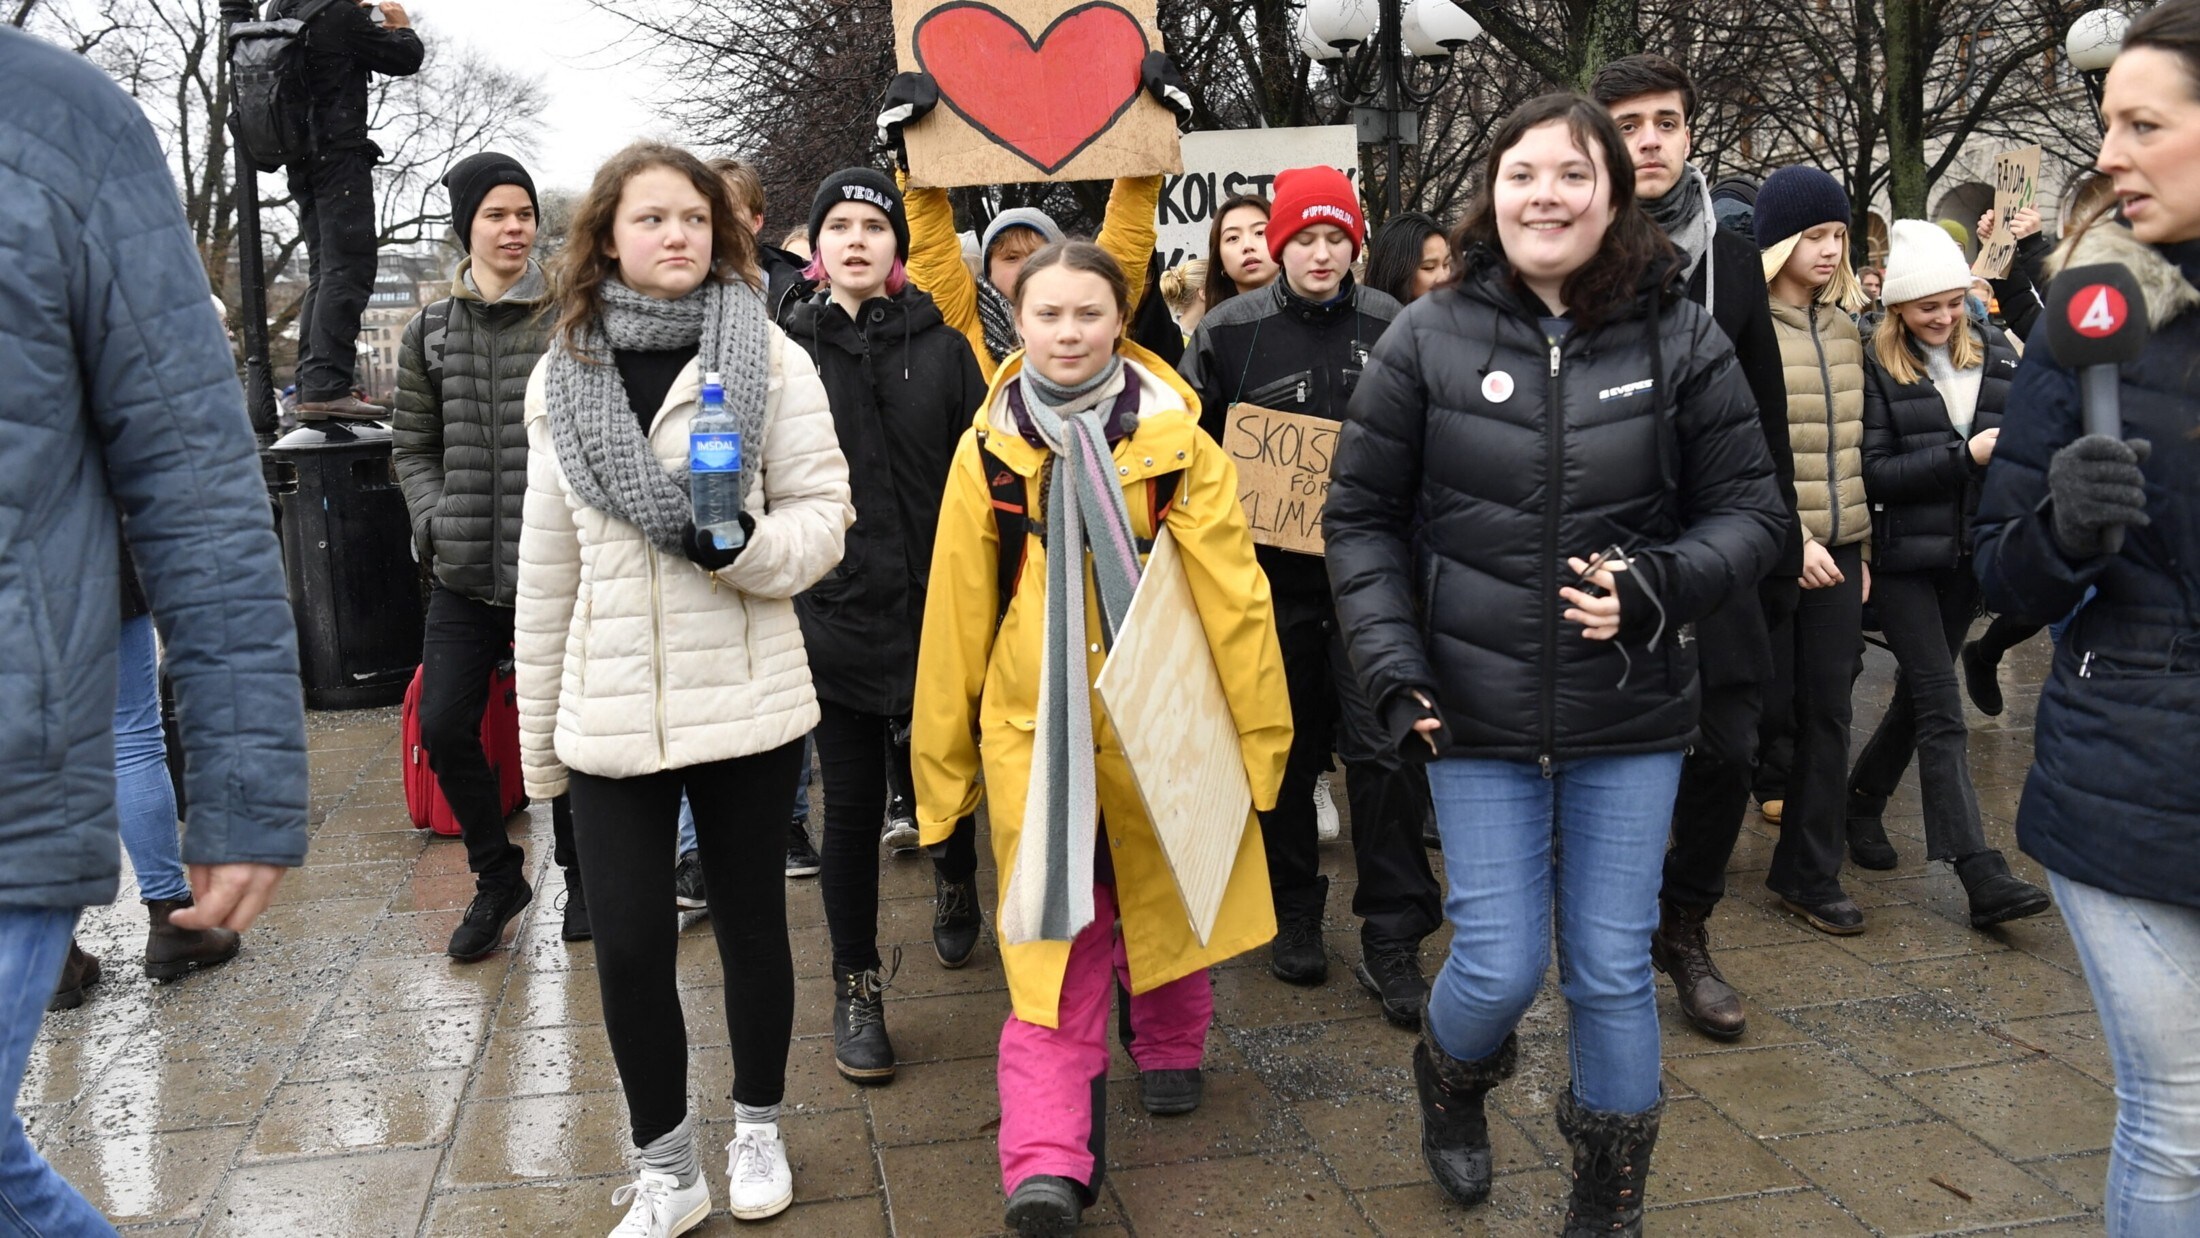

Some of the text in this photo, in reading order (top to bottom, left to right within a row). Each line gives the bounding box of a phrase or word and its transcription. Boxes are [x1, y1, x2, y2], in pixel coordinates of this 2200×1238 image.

[842, 185, 893, 212] VEGAN
[2079, 286, 2114, 330] 4
[696, 441, 735, 451] IMSDAL
[1291, 473, 1330, 496] FÖR
[1240, 490, 1323, 538] LIMA
